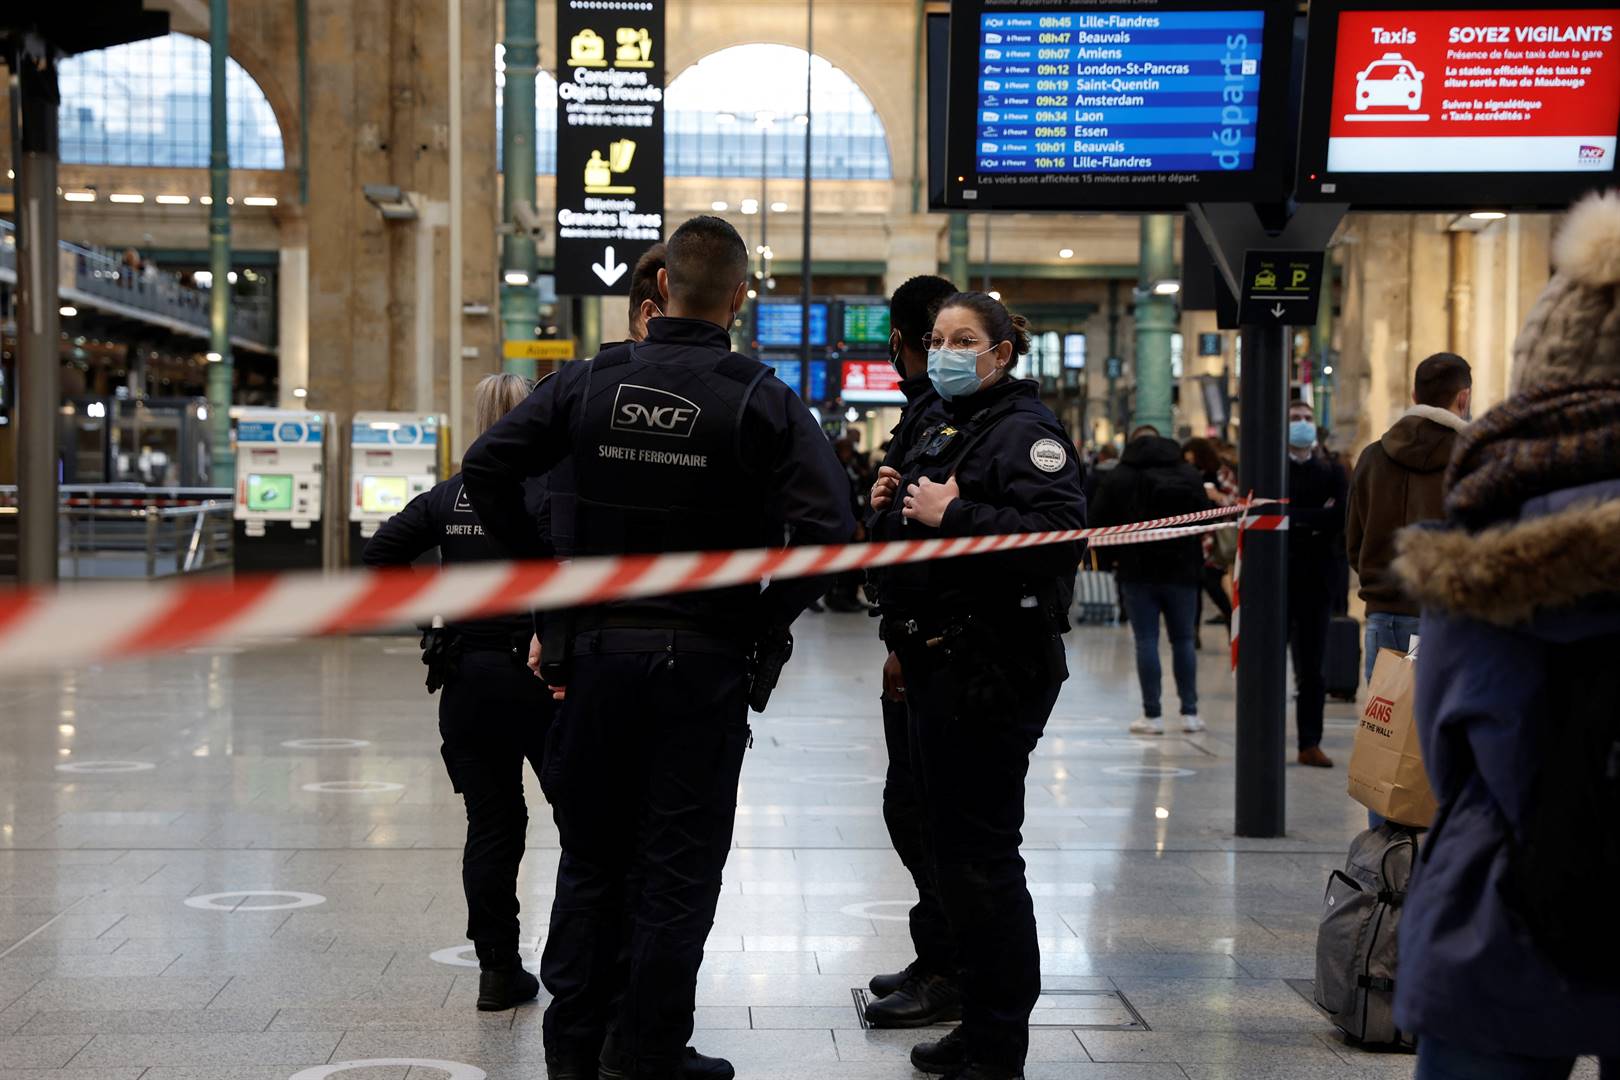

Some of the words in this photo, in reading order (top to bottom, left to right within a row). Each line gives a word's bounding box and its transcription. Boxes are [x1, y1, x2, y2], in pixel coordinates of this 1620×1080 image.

[1039, 17, 1071, 27] 08h45
[1079, 16, 1159, 27] Lille-Flandres
[1039, 33, 1071, 43] 08h47
[1079, 31, 1130, 43] Beauvais
[1371, 27, 1417, 44] Taxis
[1448, 26, 1510, 43] SOYEZ
[1515, 25, 1613, 42] VIGILANTS
[1038, 49, 1070, 59] 09h07
[1078, 47, 1122, 59] Amiens
[1489, 48, 1502, 59] de
[1504, 48, 1523, 59] faux
[1525, 49, 1546, 59] taxis
[1548, 48, 1570, 59] dans
[1572, 48, 1580, 58] la
[1582, 51, 1603, 61] gare
[1037, 65, 1069, 75] 09h12
[1077, 63, 1190, 75] London-St-Pancras
[1445, 66, 1458, 76] La
[1458, 66, 1492, 76] station
[1493, 64, 1534, 75] officielle
[1536, 64, 1554, 75] des
[1555, 64, 1579, 75] taxis
[1580, 66, 1592, 75] se
[1037, 80, 1068, 91] 09h19
[1077, 78, 1159, 92] Saint-Quentin
[1444, 77, 1468, 88] situe
[1469, 77, 1497, 88] sortie
[1499, 77, 1518, 87] Rue
[1519, 76, 1533, 87] de
[1534, 76, 1585, 89] Maubeuge
[1036, 96, 1068, 106] 09h22
[1075, 94, 1144, 106] Amsterdam
[1211, 33, 1249, 170] départs
[1442, 99, 1472, 110] Suivre
[1473, 99, 1483, 109] la
[1484, 99, 1542, 112] signalétique
[1036, 112, 1067, 122] 09h34
[1075, 110, 1104, 122] Laon
[1450, 110, 1473, 121] Taxis
[1474, 110, 1523, 121] accrédités
[1035, 127, 1067, 137] 09h55
[1074, 125, 1108, 137] Essen
[1035, 142, 1066, 152] 10h01
[1073, 140, 1125, 152] Beauvais
[1034, 158, 1065, 168] 10h16
[1073, 155, 1152, 168] Lille-Flandres
[978, 175, 993, 184] Les
[995, 175, 1017, 184] voies
[1019, 175, 1038, 184] sont
[1040, 174, 1079, 183] affichées
[1082, 174, 1092, 183] 15
[1094, 174, 1130, 183] minutes
[1131, 174, 1156, 183] avant
[1158, 173, 1167, 182] le
[1292, 270, 1307, 287] P
[616, 403, 694, 429] SNCF
[598, 445, 636, 461] SURETE
[639, 449, 708, 467] FERROVIAIRE
[445, 524, 472, 535] SURETE
[1365, 696, 1394, 724] VANS
[1366, 721, 1376, 732] THE
